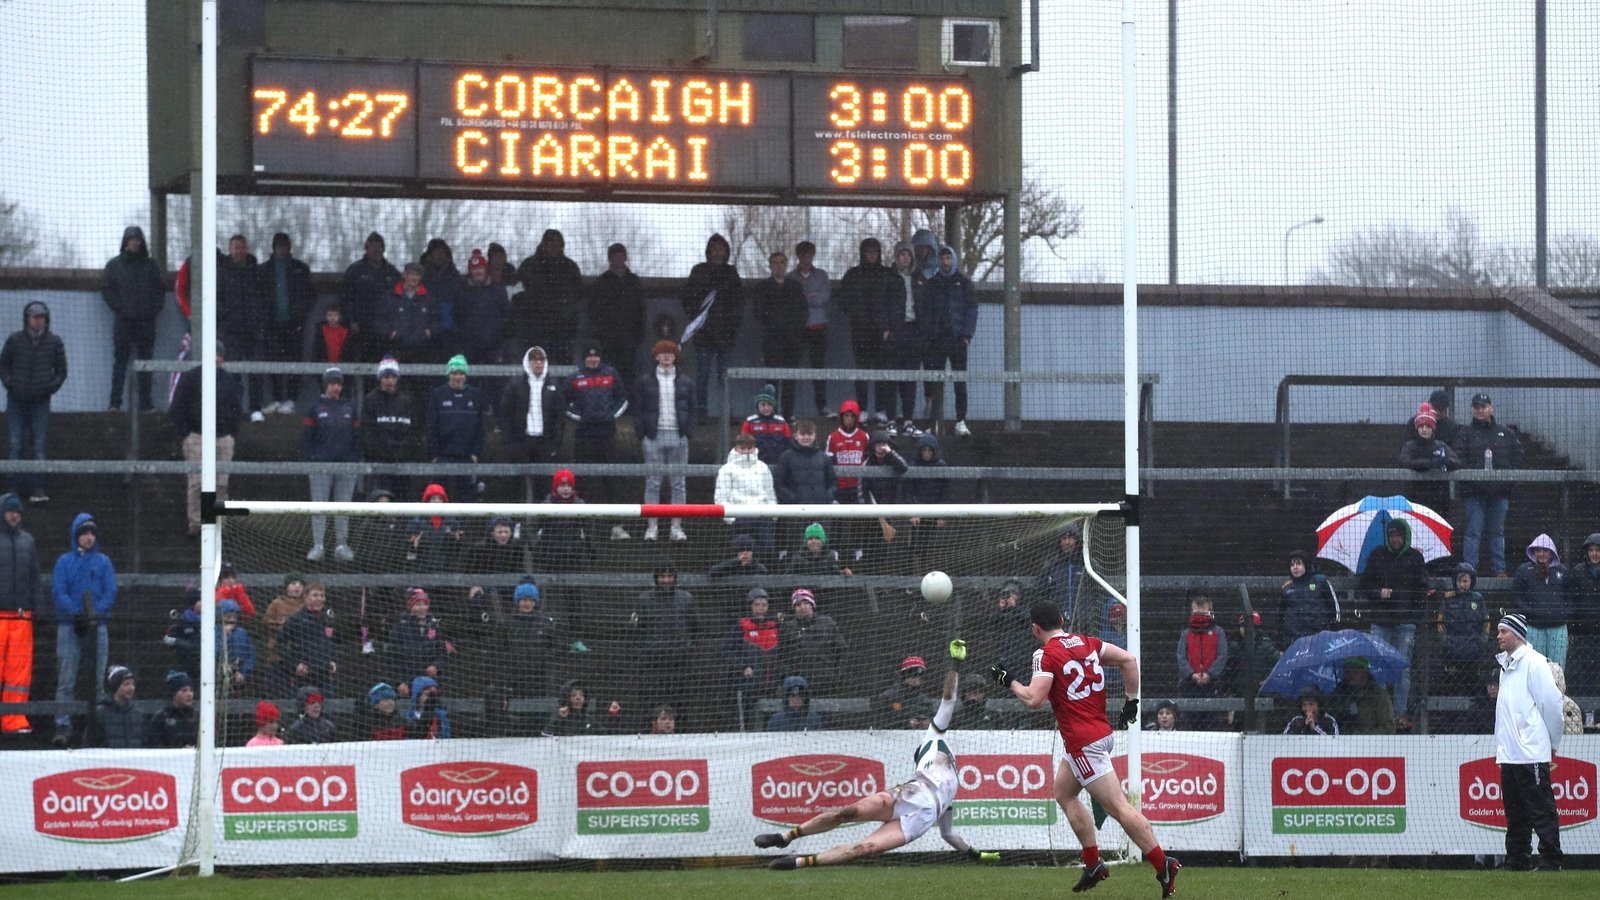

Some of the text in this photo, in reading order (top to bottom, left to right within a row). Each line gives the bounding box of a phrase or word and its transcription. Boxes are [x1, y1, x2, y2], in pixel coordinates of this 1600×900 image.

[253, 89, 409, 138] 74:27
[455, 72, 753, 125] CORCAIGH
[829, 83, 972, 130] 3:00
[455, 130, 709, 182] CIARRAI
[829, 132, 972, 186] 3:00
[1062, 650, 1105, 701] 23
[760, 775, 878, 806] dairygold
[958, 764, 1046, 794] o-op
[42, 786, 169, 820] dairygold
[410, 781, 530, 813] dairygold
[1158, 803, 1186, 811] Growing
[1188, 803, 1217, 812] Naturally
[235, 819, 348, 834] SUPERSTORES
[588, 813, 700, 828] SUPERSTORES
[953, 807, 1047, 820] UPERSTORES
[1283, 814, 1396, 827] SUPERSTORES
